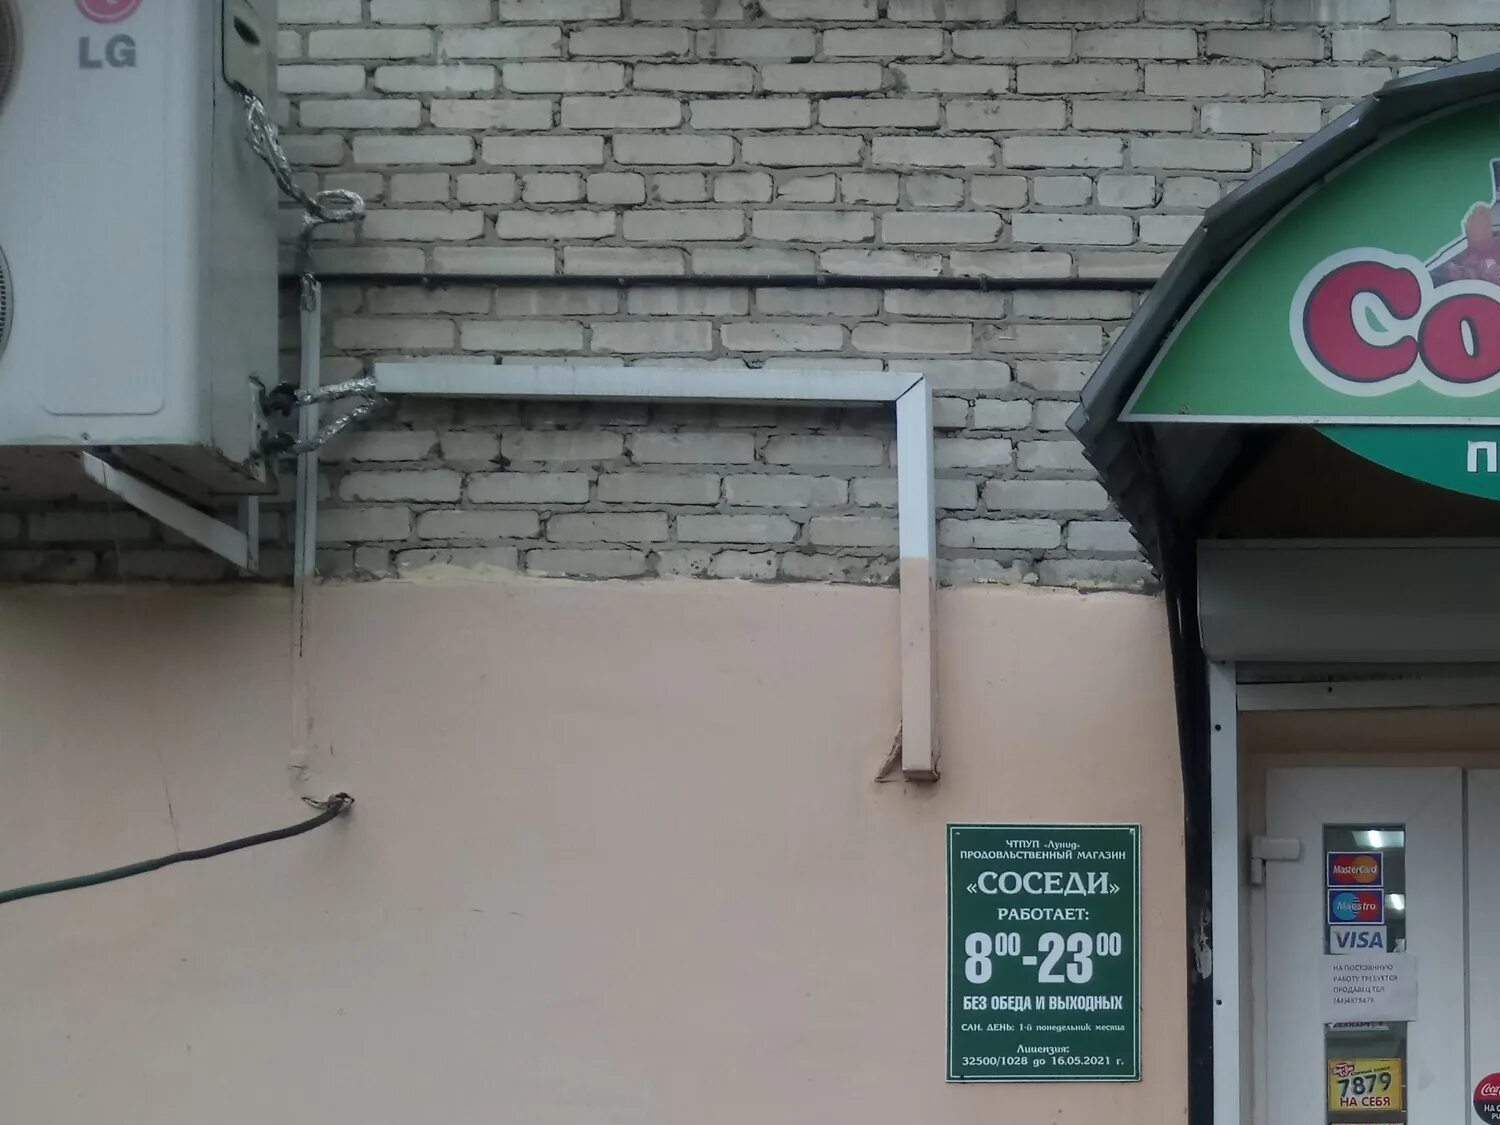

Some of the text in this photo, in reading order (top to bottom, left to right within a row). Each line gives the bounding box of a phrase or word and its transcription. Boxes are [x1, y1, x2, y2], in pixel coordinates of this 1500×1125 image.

[78, 34, 137, 69] LG
[1005, 839, 1040, 849] ЧТПУП
[960, 850, 1126, 860] ПРОДОВЛЬСТВЕННЫЙ МАГАЗИН
[1332, 864, 1378, 875] MasterCard
[966, 871, 1120, 897] «СОСЕДИ»
[1336, 901, 1376, 911] Maestro
[997, 907, 1090, 921] РАБОТАЕТ:
[1333, 931, 1384, 949] VISA
[963, 995, 1124, 1012] БЕЗ ОБЕДА И ВЫХОДНЫХ
[961, 1023, 984, 1032] САН.
[986, 1023, 1015, 1032] ДЕНЬ:
[1036, 1023, 1092, 1033] понедельник
[1016, 1044, 1070, 1055] Лицензия:
[962, 1056, 1028, 1067] 32500/1028
[1032, 1058, 1046, 1067] до
[1051, 1056, 1110, 1066] 16.05.2021
[1337, 1071, 1392, 1097] 7879
[1340, 1096, 1391, 1107] НА СЕБЯ
[1484, 1104, 1495, 1112] НА
